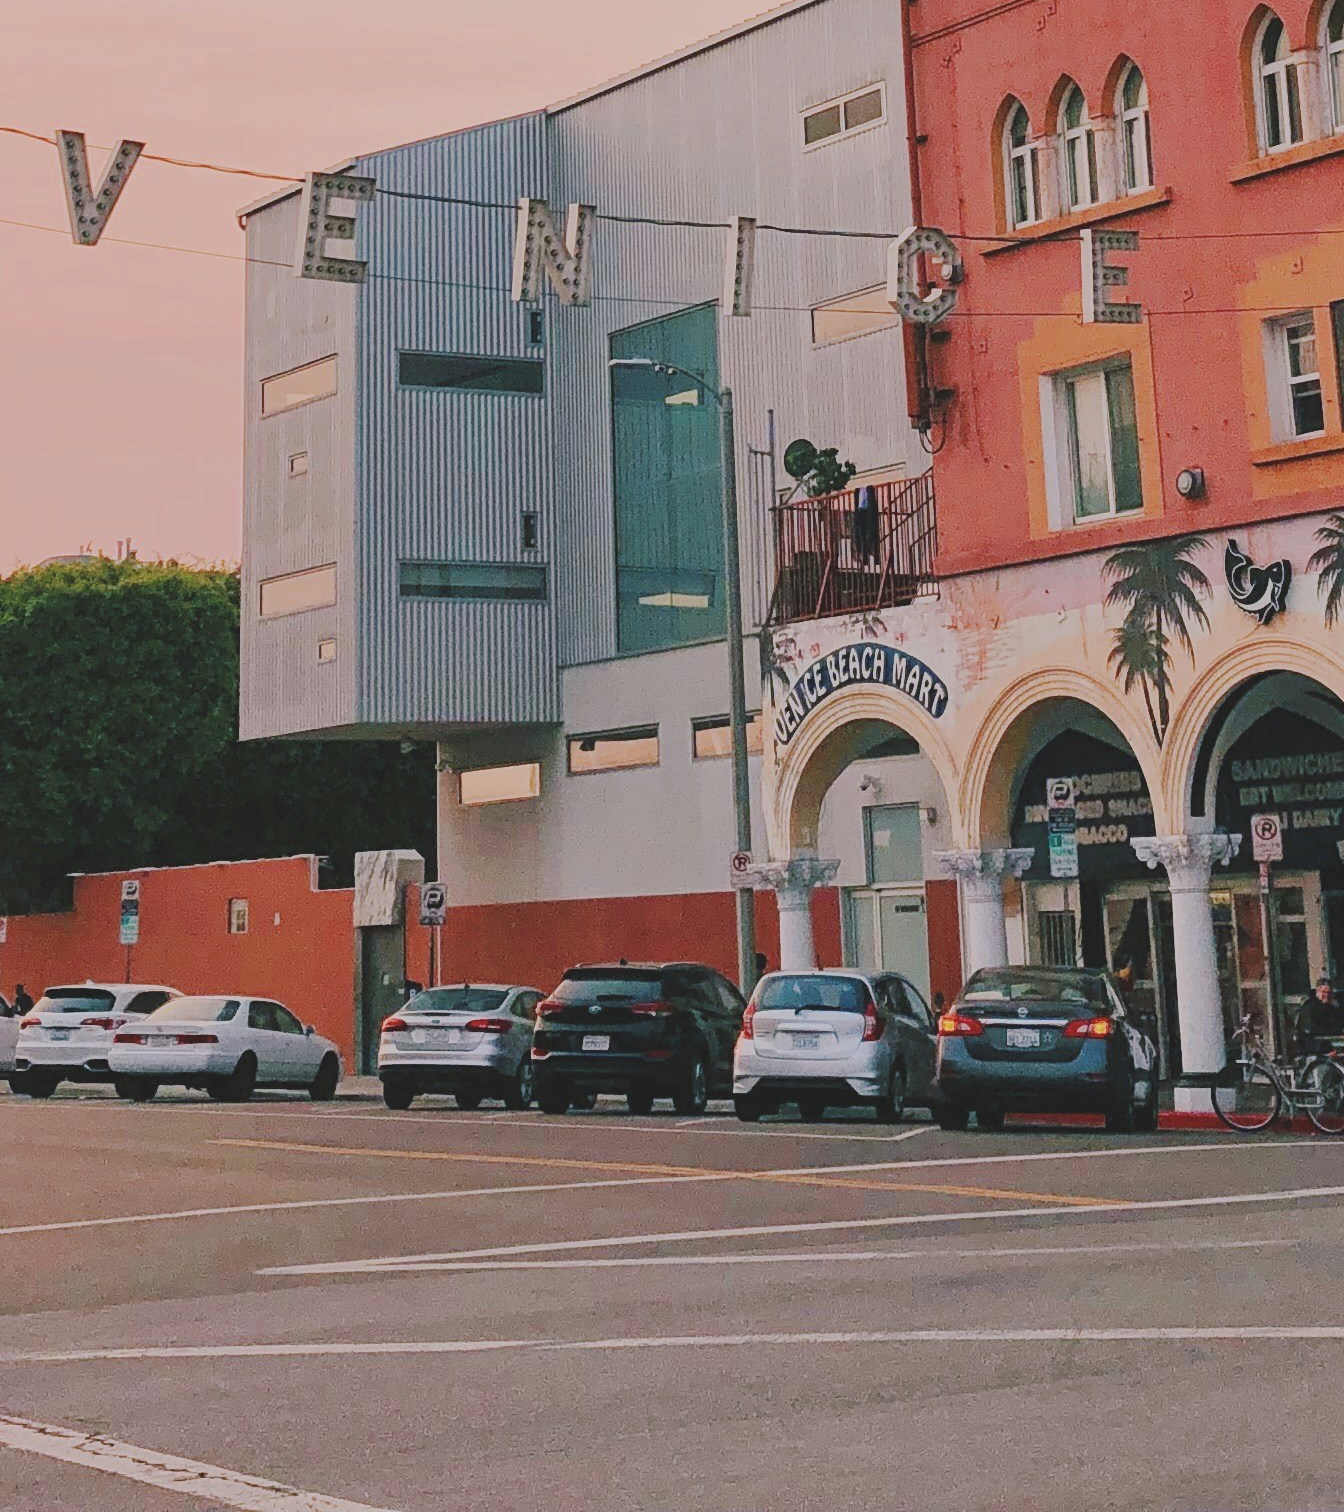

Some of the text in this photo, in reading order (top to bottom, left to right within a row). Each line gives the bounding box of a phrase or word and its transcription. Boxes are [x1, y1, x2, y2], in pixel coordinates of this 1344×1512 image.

[54, 129, 1143, 324] VENICE
[826, 646, 885, 688] BEACH
[892, 651, 945, 717] MART
